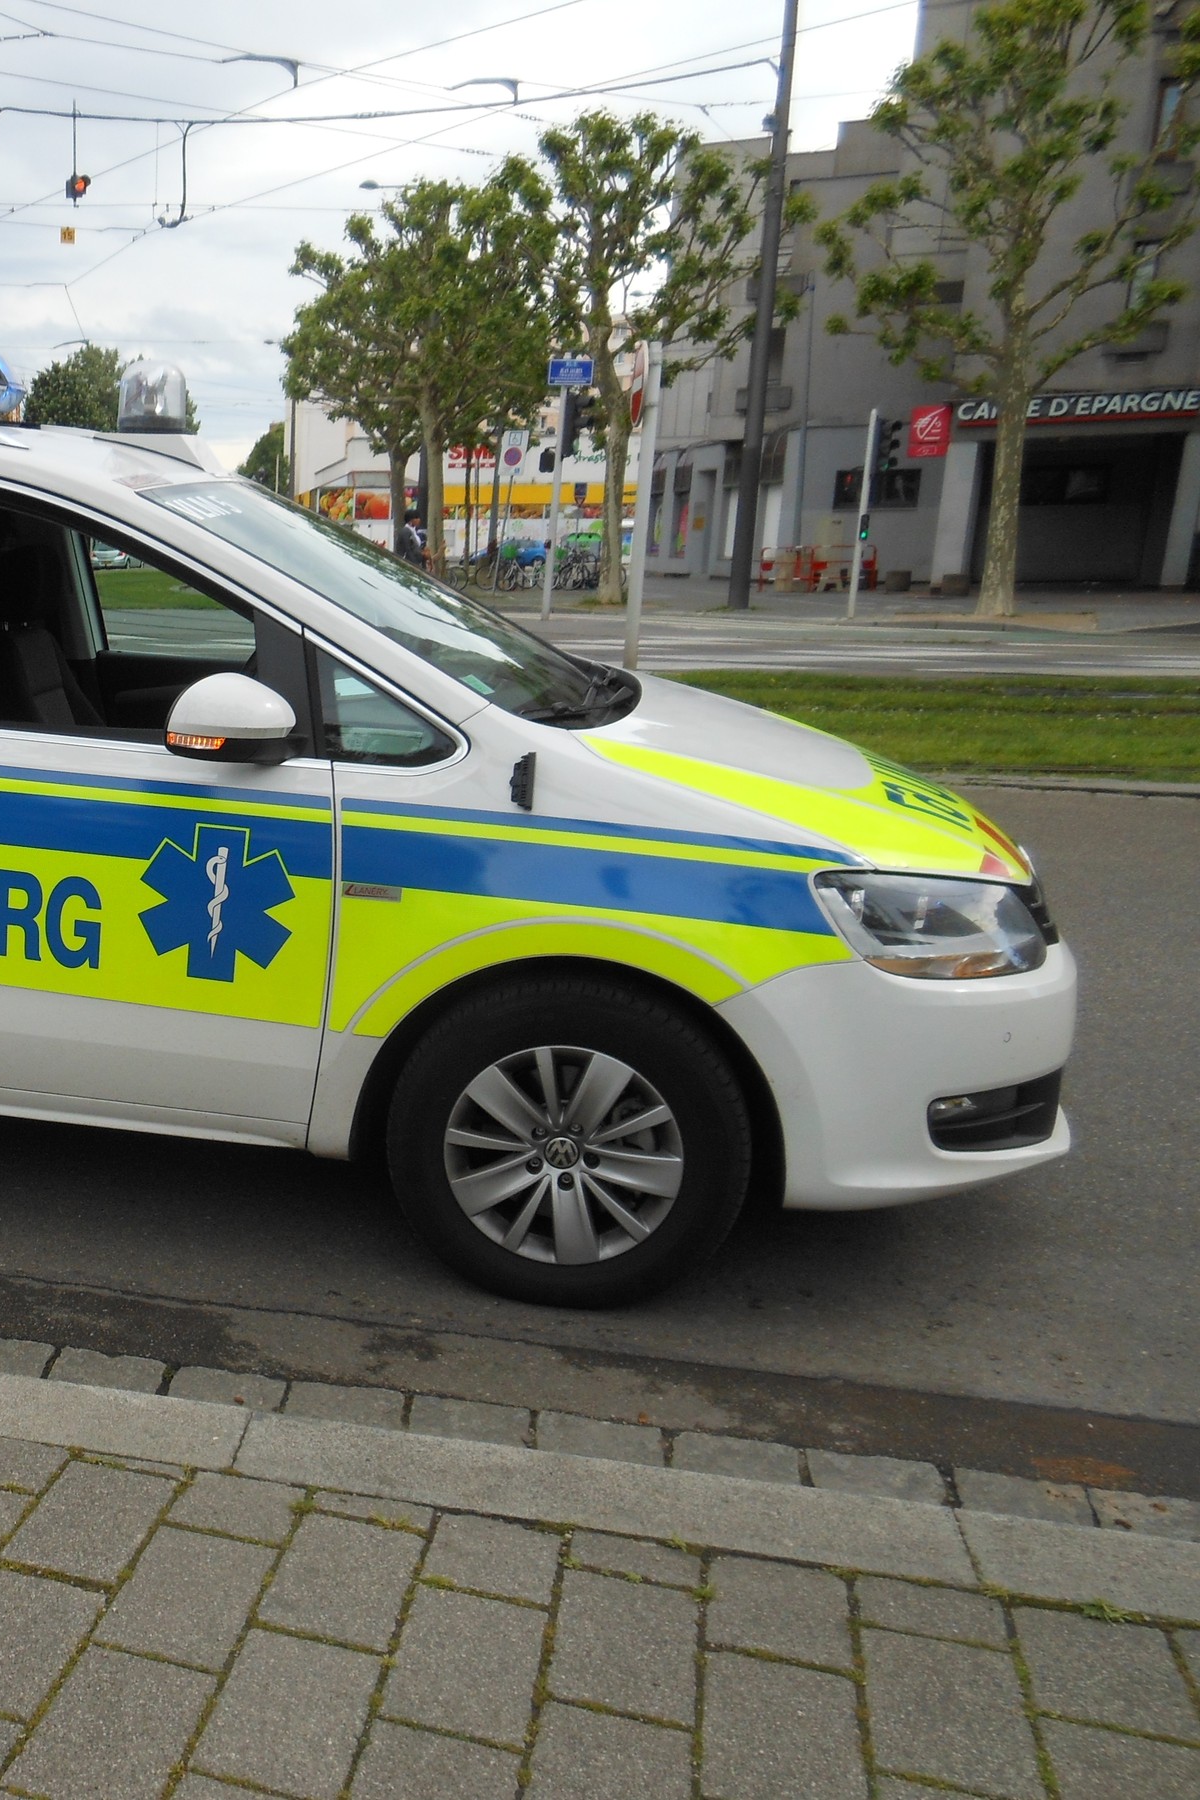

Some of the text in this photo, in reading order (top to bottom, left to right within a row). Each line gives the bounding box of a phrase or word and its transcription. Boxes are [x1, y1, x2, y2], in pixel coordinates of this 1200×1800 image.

[63, 231, 73, 240] 15
[957, 390, 1200, 420] CAIE D'EPARGNE
